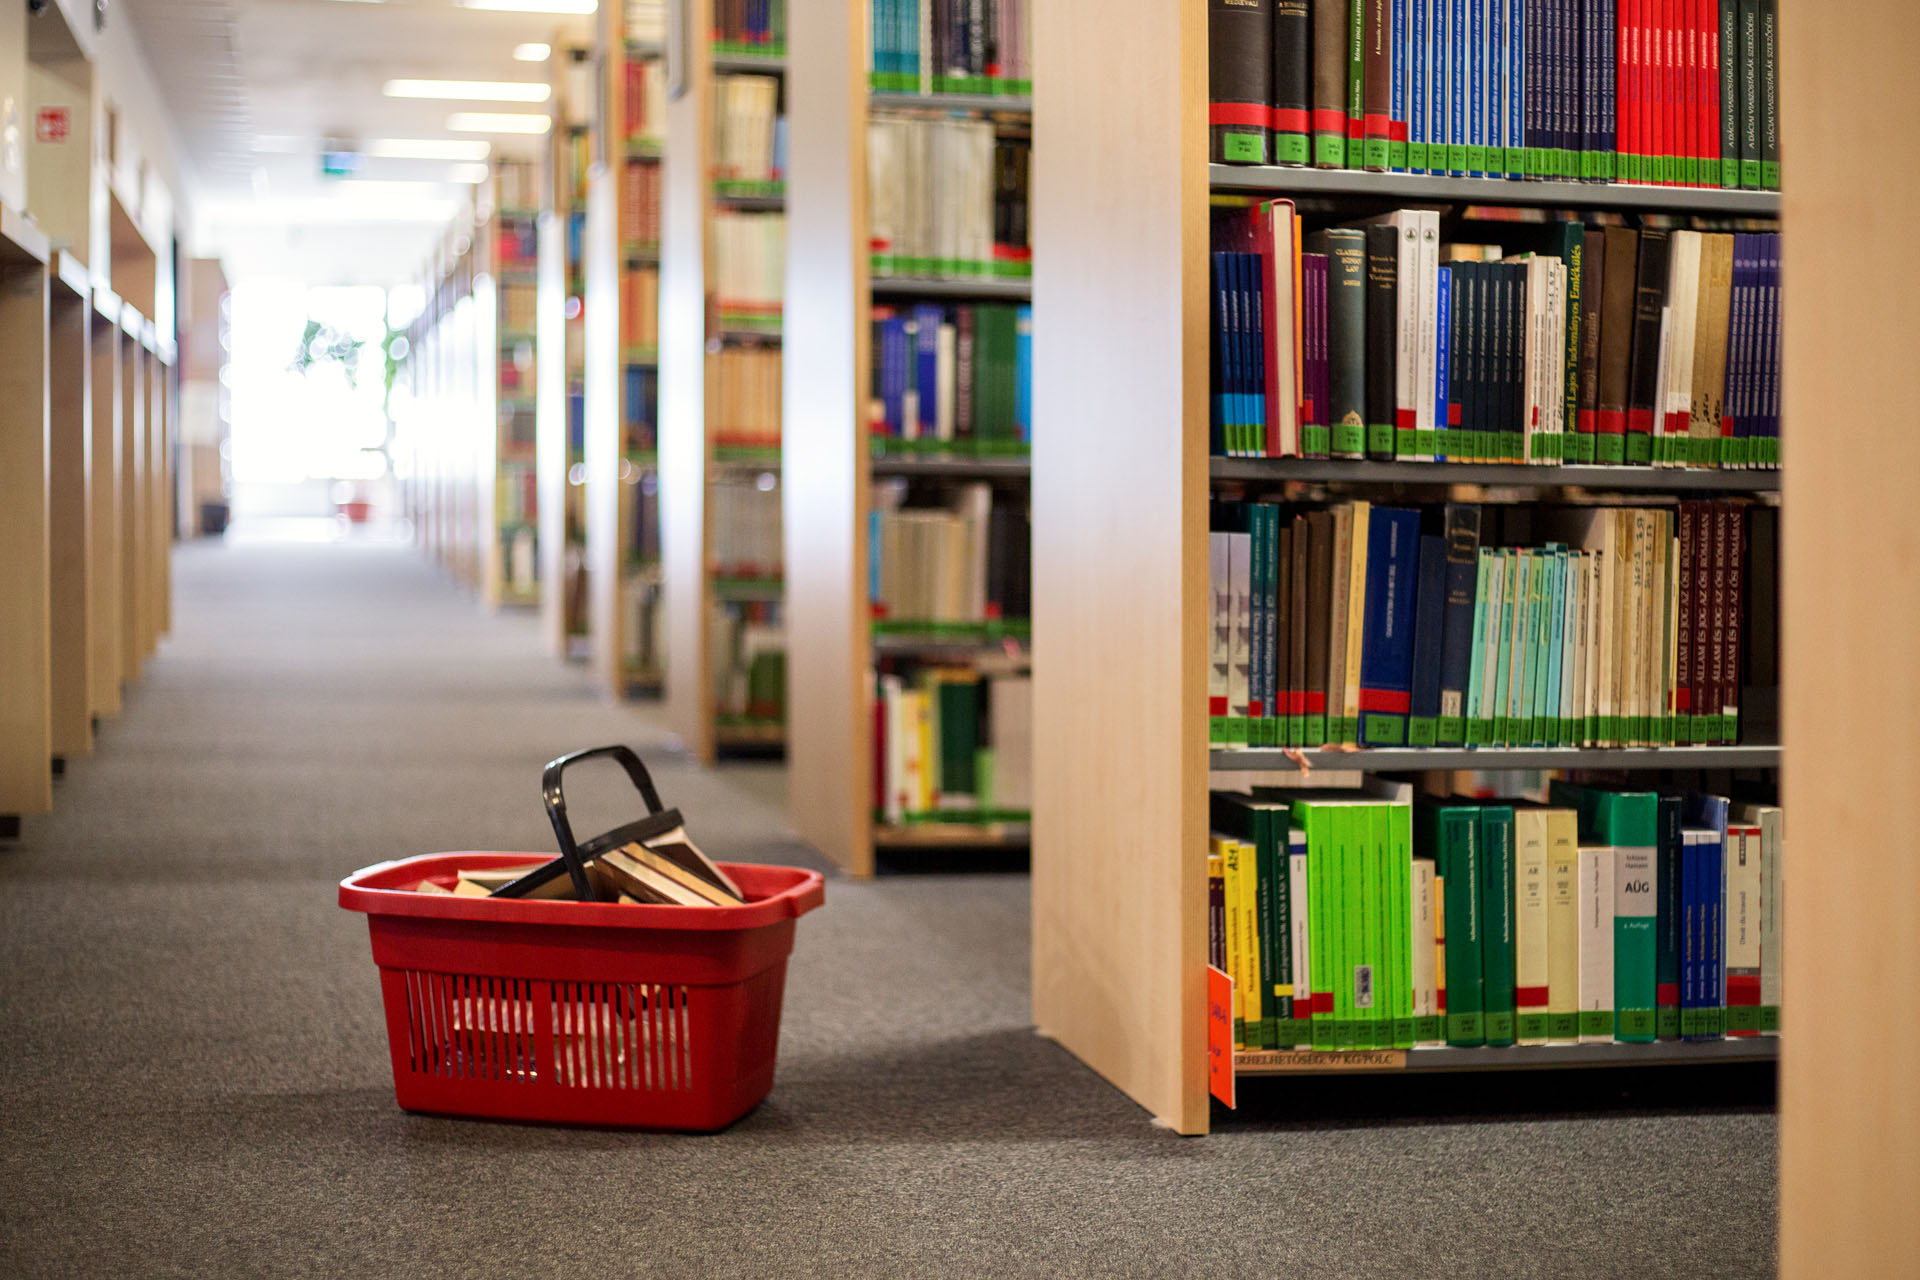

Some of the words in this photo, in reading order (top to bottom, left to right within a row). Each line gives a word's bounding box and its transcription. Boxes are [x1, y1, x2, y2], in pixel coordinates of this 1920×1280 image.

[1725, 12, 1733, 56] SZERZŐDÉSEI
[1746, 13, 1754, 57] SZERZŐDÉSEI
[1764, 14, 1773, 58] SZERZŐDÉSEI
[1726, 58, 1734, 113] VIASZOSTÁBLÁK
[1746, 58, 1754, 113] VIASZOSTÁBLÁK
[1766, 60, 1774, 115] VIASZOSTÁBLÁK
[1727, 115, 1735, 140] DÁCIAI
[1747, 116, 1755, 141] DÁCIAI
[1767, 117, 1775, 142] DÁCIAI
[1570, 245, 1581, 299] Emlékülés
[1568, 302, 1580, 368] Tudományos
[1568, 372, 1578, 401] Lajos
[1568, 404, 1576, 433] zamel
[1681, 514, 1691, 567] RÓMÁBAN
[1698, 514, 1709, 567] RÓMÁBAN
[1714, 513, 1725, 567] RÓMÁBAN
[1730, 513, 1740, 567] RÓMÁBAN
[1681, 571, 1690, 588] ŐSI
[1698, 571, 1708, 588] ŐSI
[1714, 570, 1723, 587] ŐSI
[1729, 570, 1738, 587] ŐSI
[1682, 591, 1689, 606] AZ
[1699, 590, 1707, 606] AZ
[1715, 590, 1723, 605] AZ
[1730, 589, 1738, 605] AZ
[1681, 607, 1689, 628] JOG
[1699, 607, 1707, 628] JOG
[1715, 607, 1723, 627] JOG
[1729, 607, 1738, 627] JOG
[1679, 631, 1689, 643] ÉS
[1697, 630, 1706, 643] ÉS
[1712, 630, 1722, 642] ÉS
[1727, 629, 1737, 641] ÉS
[1679, 646, 1688, 683] ÁLLAM
[1697, 646, 1706, 683] ÁLLAM
[1712, 645, 1722, 683] ÁLLAM
[1726, 645, 1736, 682] ÁLLAM
[1625, 880, 1649, 893] AÜG
[1630, 922, 1649, 930] Auflage
[1740, 916, 1745, 925] du
